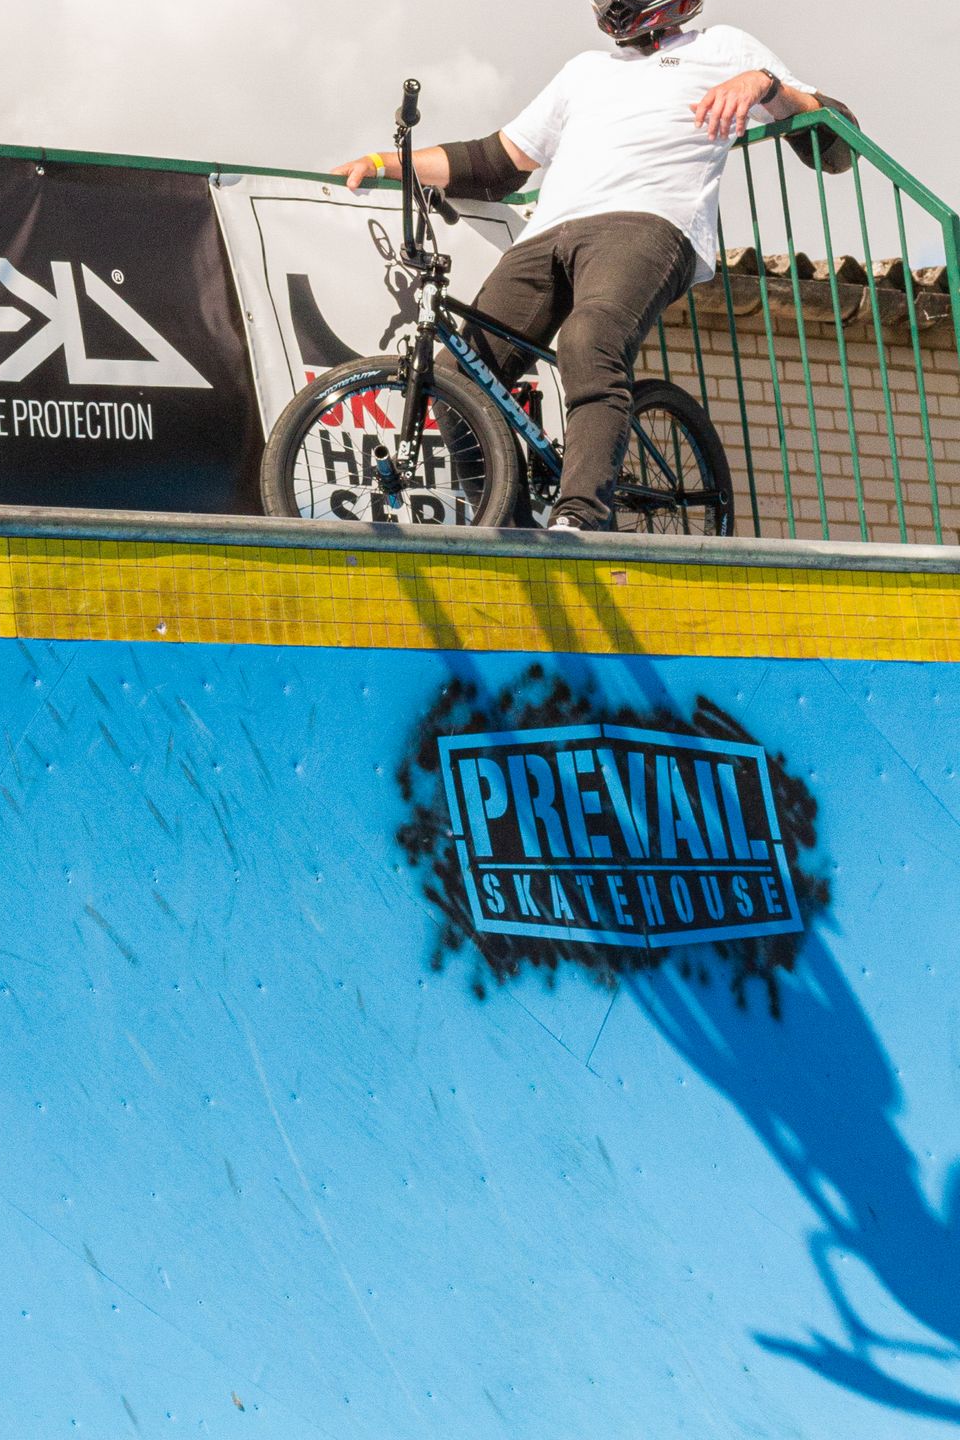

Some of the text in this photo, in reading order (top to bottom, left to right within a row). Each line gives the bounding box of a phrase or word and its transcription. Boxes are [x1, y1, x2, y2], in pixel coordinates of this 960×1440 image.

[660, 56, 681, 66] VANS
[13, 399, 154, 441] PROTECTION
[458, 748, 768, 860] PREVAIL
[482, 872, 783, 927] SKATEHOUSE
